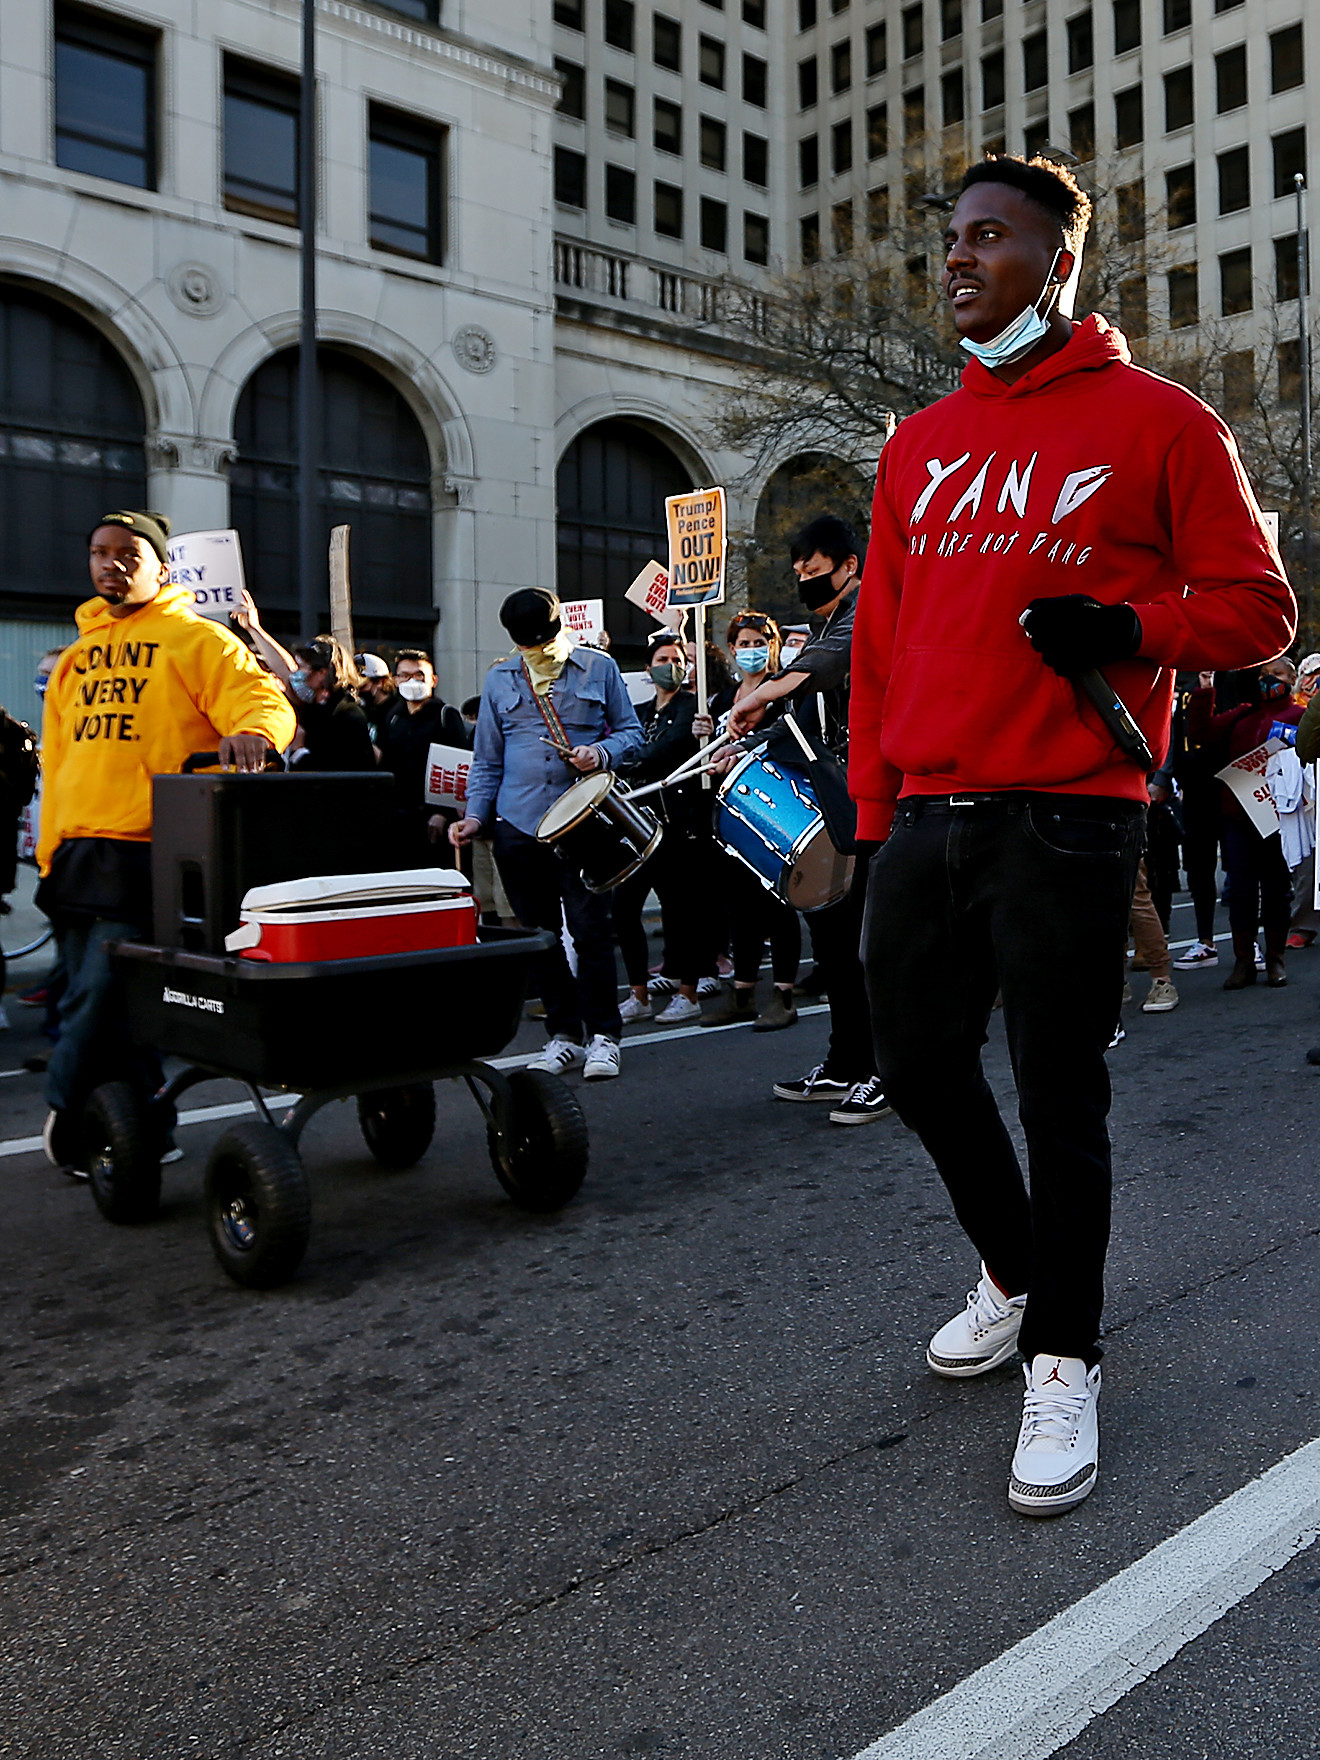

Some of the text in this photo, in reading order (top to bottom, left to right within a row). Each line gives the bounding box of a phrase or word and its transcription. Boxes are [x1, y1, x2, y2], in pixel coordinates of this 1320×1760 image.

[672, 495, 717, 518] Trump/
[678, 516, 716, 534] Pence
[681, 531, 715, 559] OUT
[937, 530, 974, 558] ARE
[979, 530, 1020, 555] NOT
[171, 565, 206, 584] ERY
[673, 556, 720, 586] NOW!
[195, 586, 234, 604] OTE
[75, 677, 148, 706] VERY
